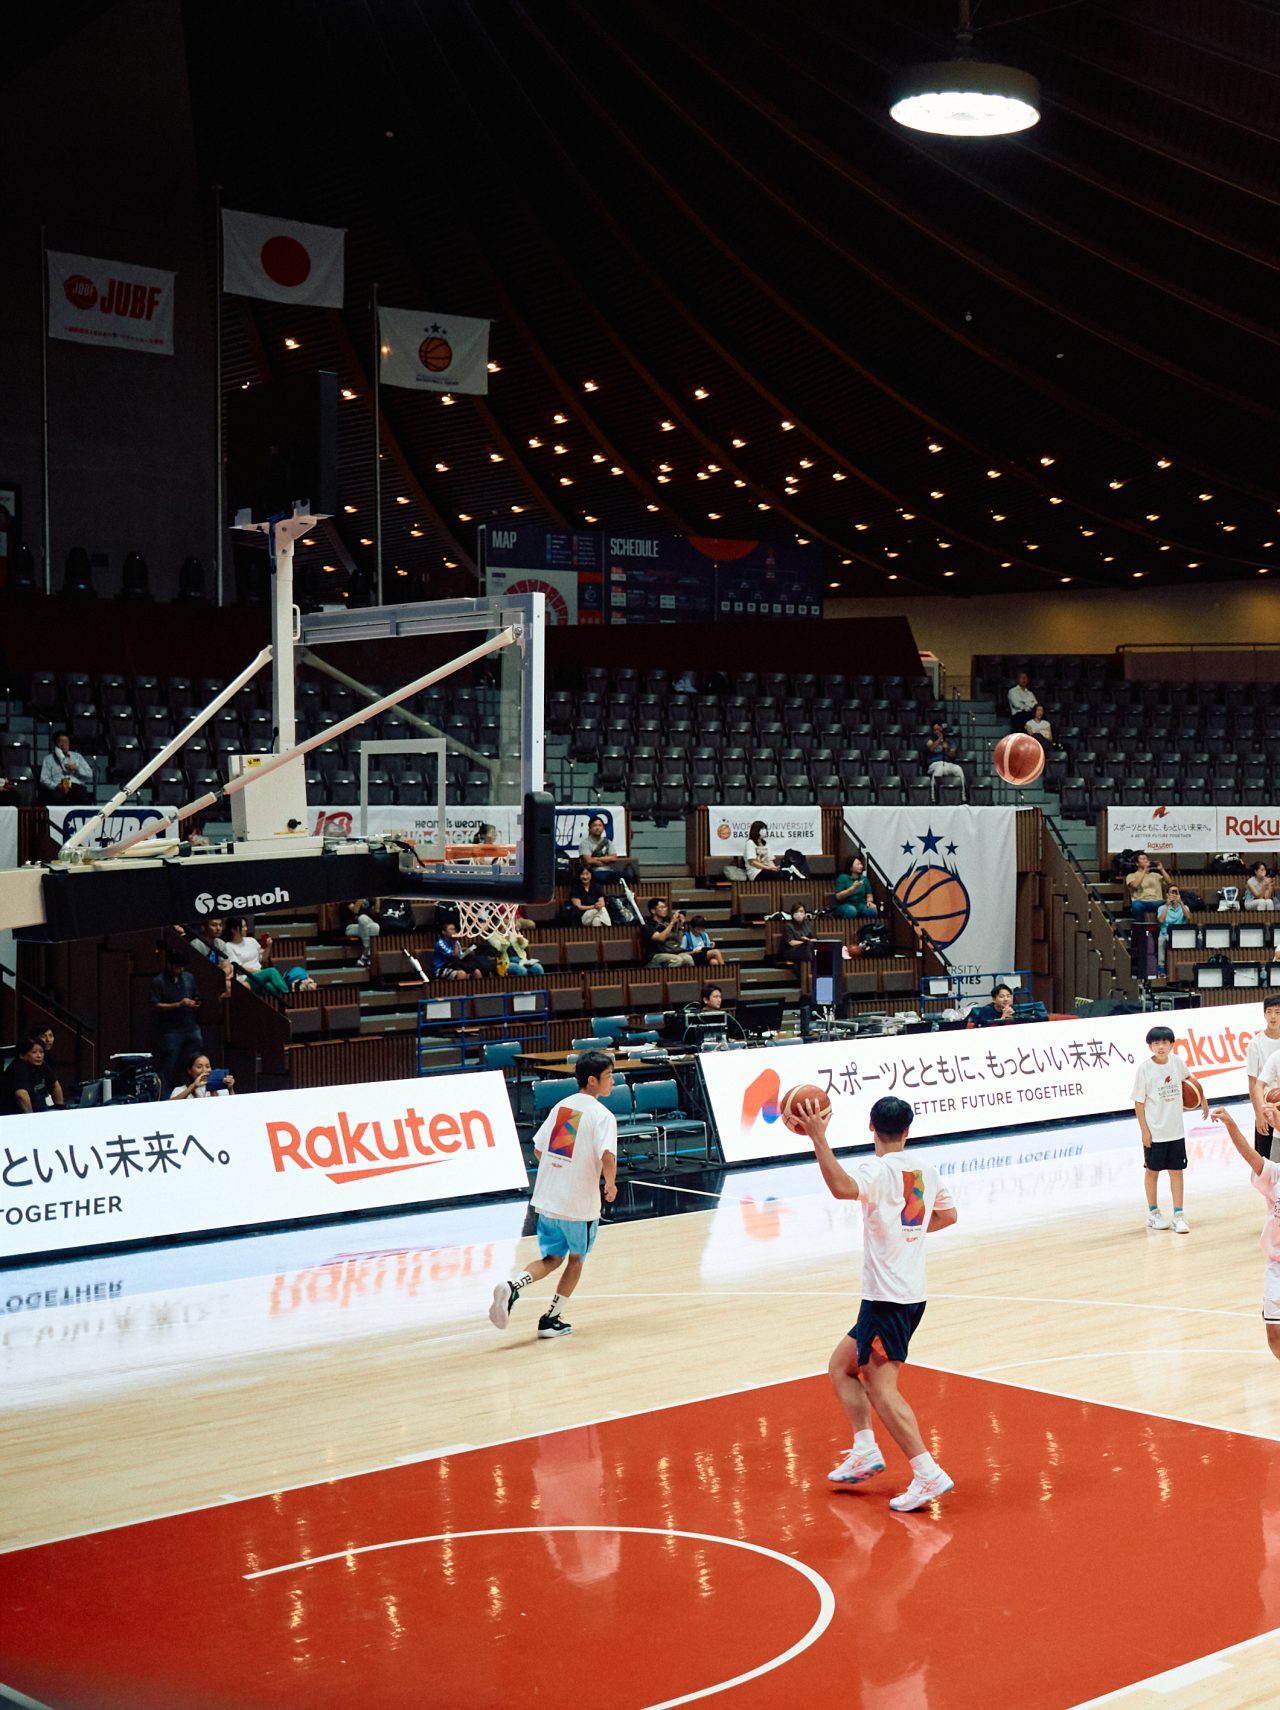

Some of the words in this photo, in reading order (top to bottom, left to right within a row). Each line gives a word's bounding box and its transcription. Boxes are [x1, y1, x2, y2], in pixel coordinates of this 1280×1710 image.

[100, 279, 162, 321] JUBF
[492, 530, 518, 550] MAP
[610, 537, 660, 558] SCHEDULE
[733, 830, 784, 839] BASBALL
[787, 830, 815, 839] SERIES
[217, 887, 290, 911] Senoh
[818, 1038, 1136, 1097] スポーツとともに、もっといい未来へ。
[914, 1094, 957, 1116] ETTER
[961, 1090, 1012, 1111] FUTURE
[1017, 1082, 1084, 1104] TOGETHER
[266, 1107, 496, 1173] Rakuten
[1, 1130, 231, 1188] といい未来へ。
